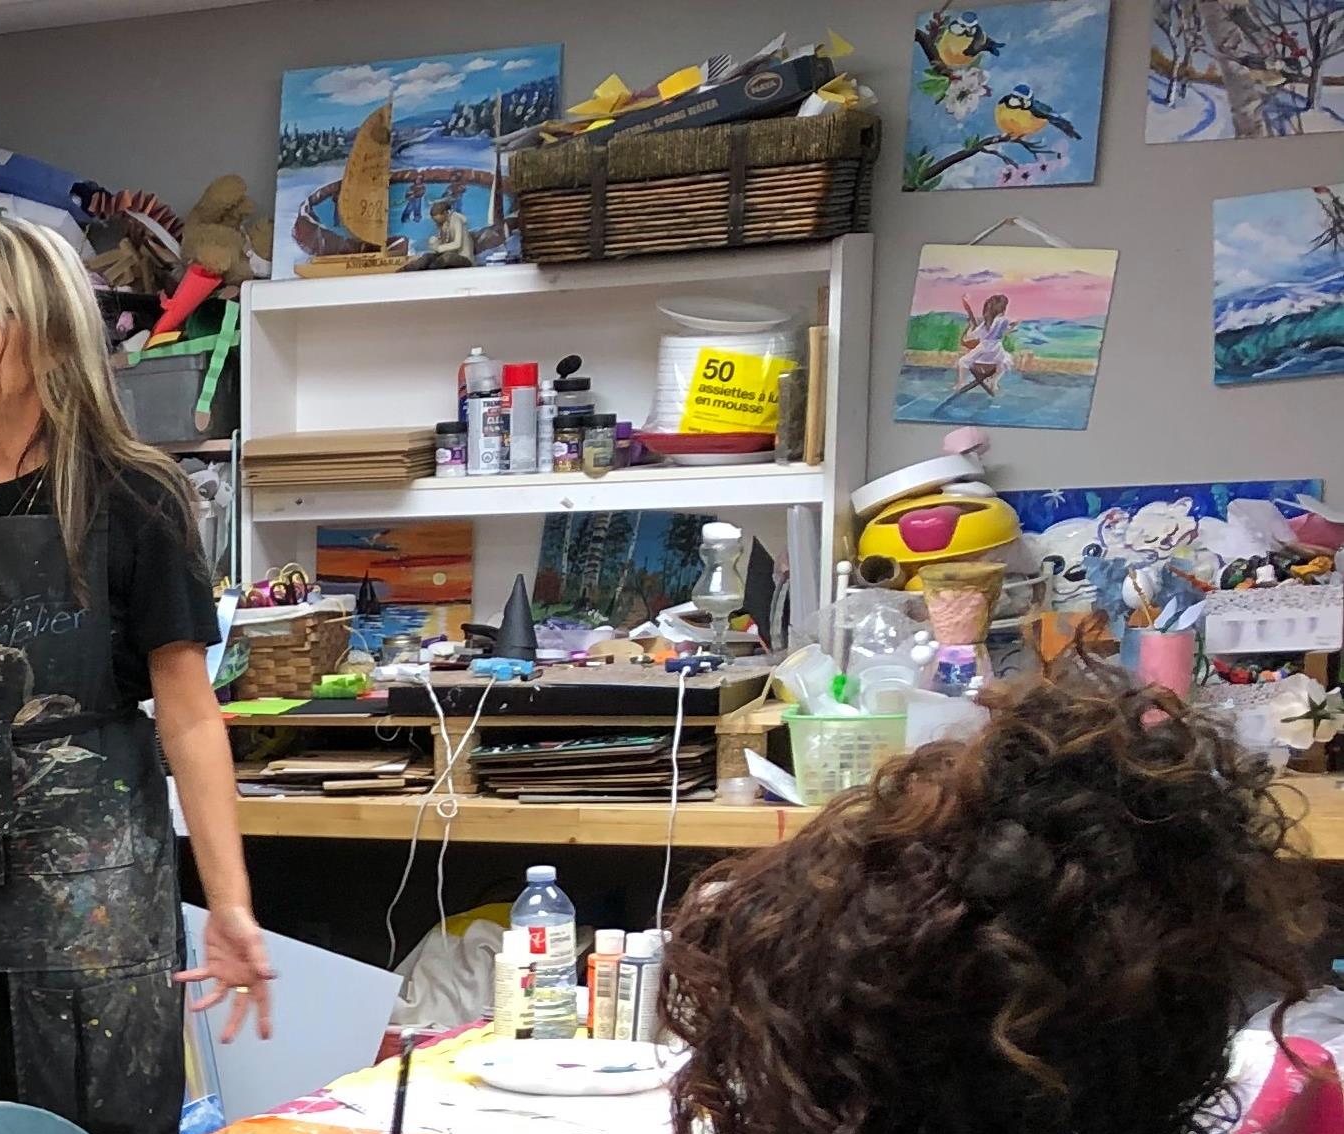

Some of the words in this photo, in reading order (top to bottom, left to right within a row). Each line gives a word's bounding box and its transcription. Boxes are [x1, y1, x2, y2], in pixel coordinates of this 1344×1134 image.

[688, 98, 719, 116] WATER
[702, 358, 735, 382] 50
[698, 383, 756, 401] assiettes
[695, 395, 711, 405] en
[712, 397, 764, 414] mousse
